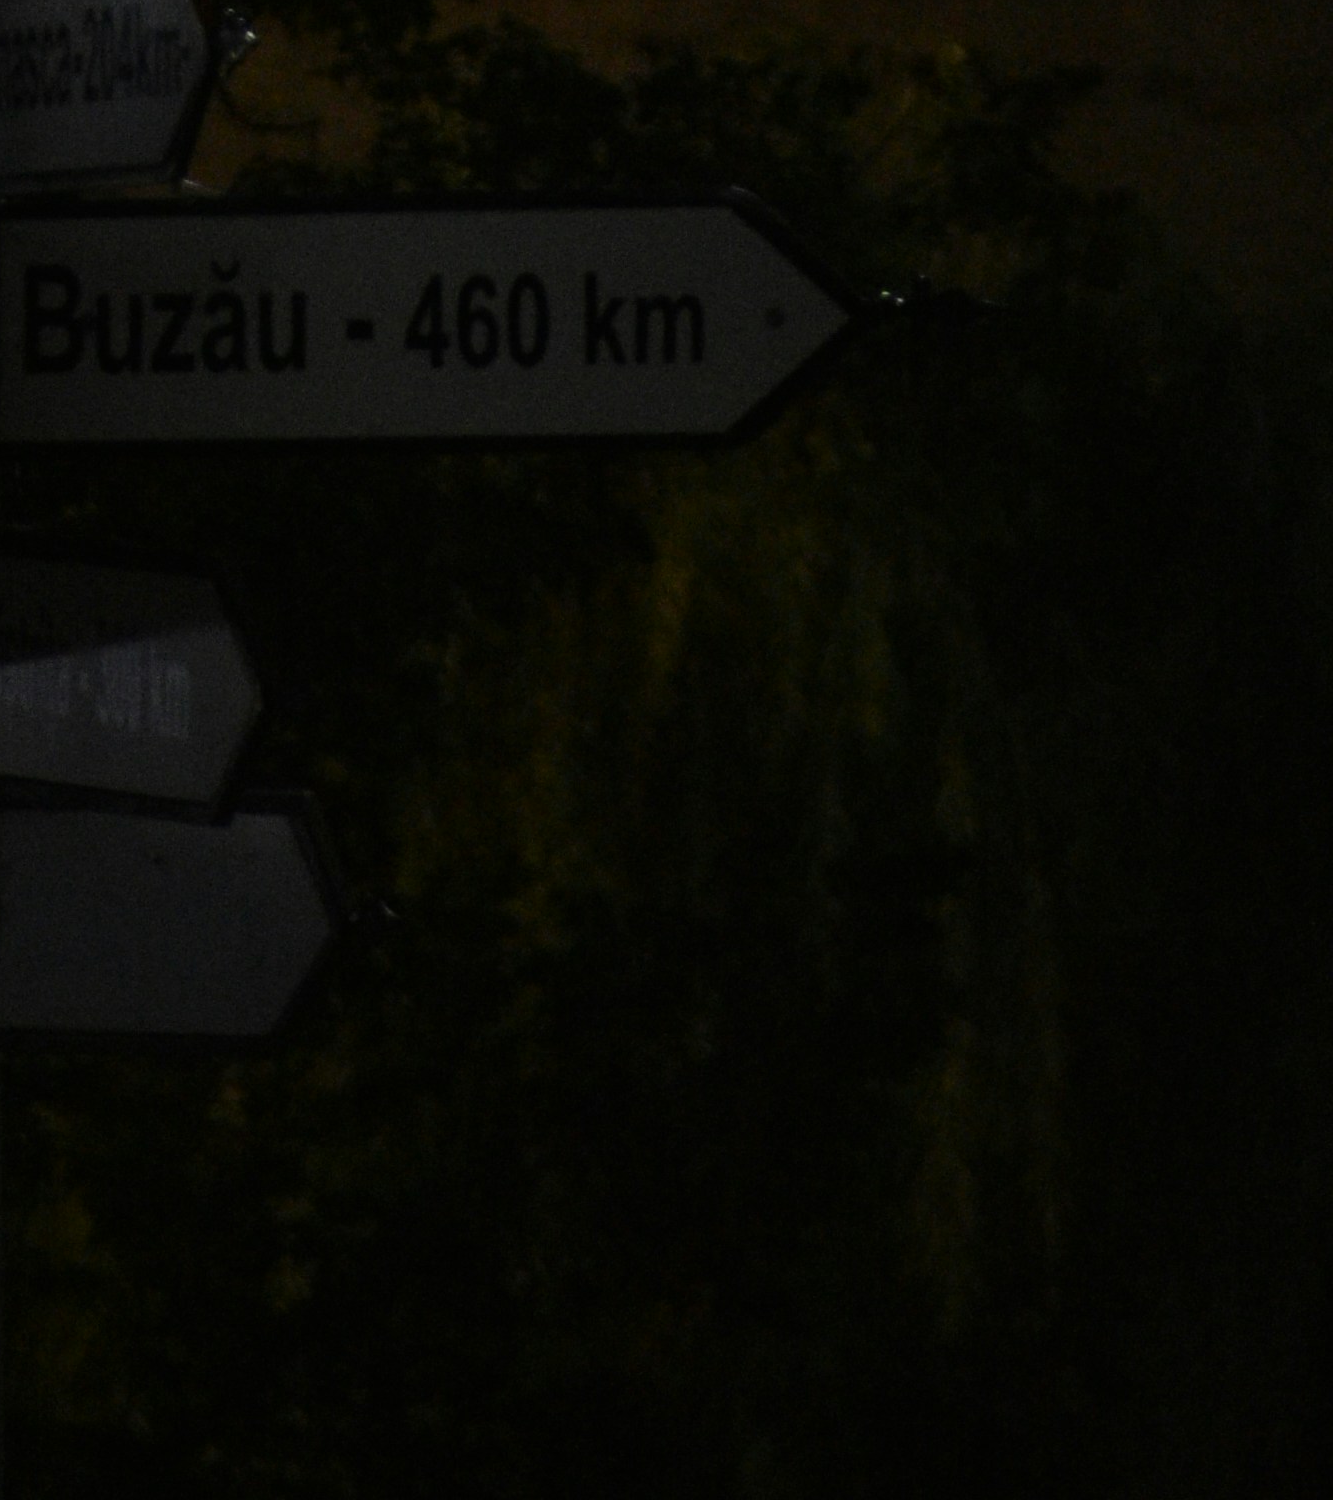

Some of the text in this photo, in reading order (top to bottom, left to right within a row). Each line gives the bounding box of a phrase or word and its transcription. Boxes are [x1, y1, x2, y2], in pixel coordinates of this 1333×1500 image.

[22, 259, 307, 375] Buzău
[404, 273, 550, 370] 460
[584, 273, 706, 366] km
